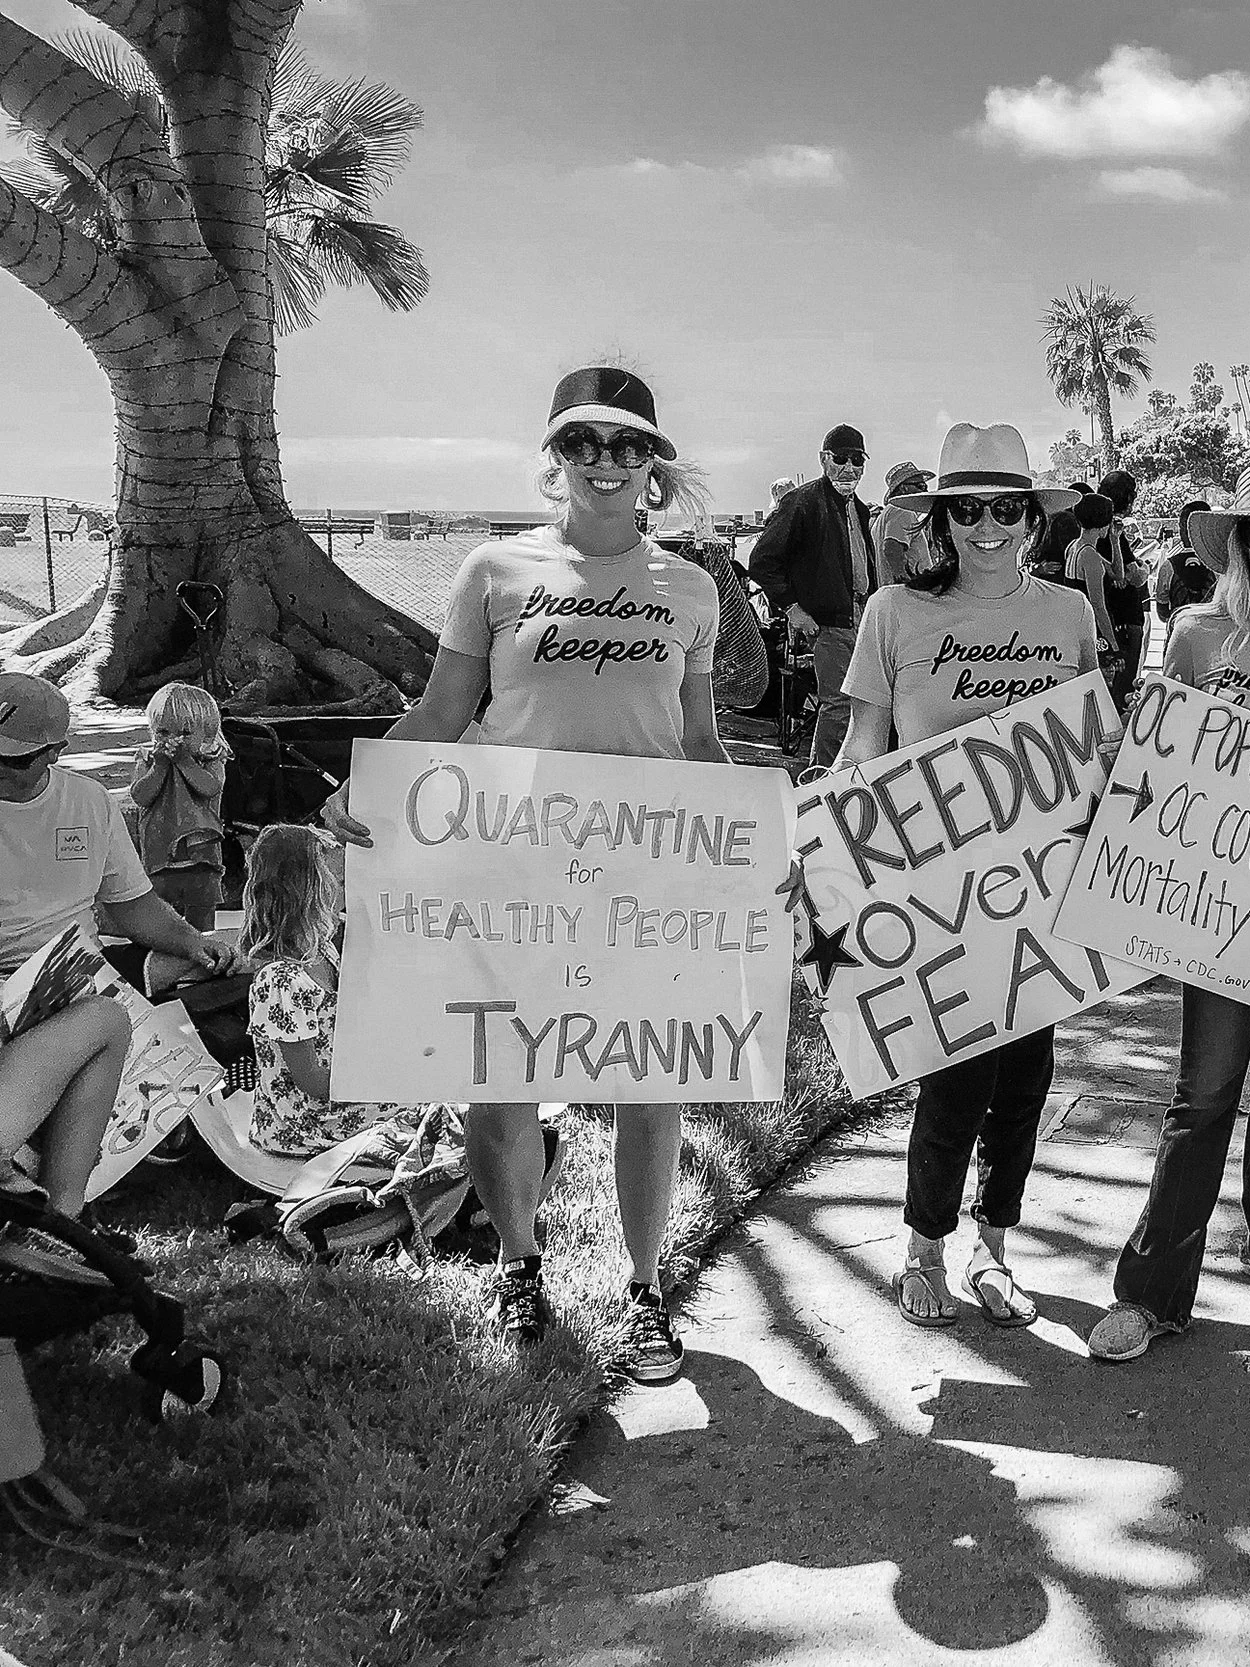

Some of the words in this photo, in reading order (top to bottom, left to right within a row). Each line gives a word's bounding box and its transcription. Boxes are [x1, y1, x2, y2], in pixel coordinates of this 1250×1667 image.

[515, 585, 674, 633] freedom
[533, 624, 669, 675] keeper
[931, 630, 1062, 675] freedom
[951, 668, 1059, 706] keeper
[1131, 683, 1186, 757] OC
[405, 764, 757, 867] QUARANTINE
[797, 689, 1110, 919] FREEDOM
[1157, 782, 1208, 848] OC
[565, 858, 604, 885] for
[380, 892, 583, 943] HEALTHY
[607, 894, 769, 953] PEOPLE
[856, 838, 1071, 969] over
[1125, 936, 1172, 965] STATS
[857, 927, 1110, 1080] FEA
[445, 1000, 763, 1085] TYRANNY
